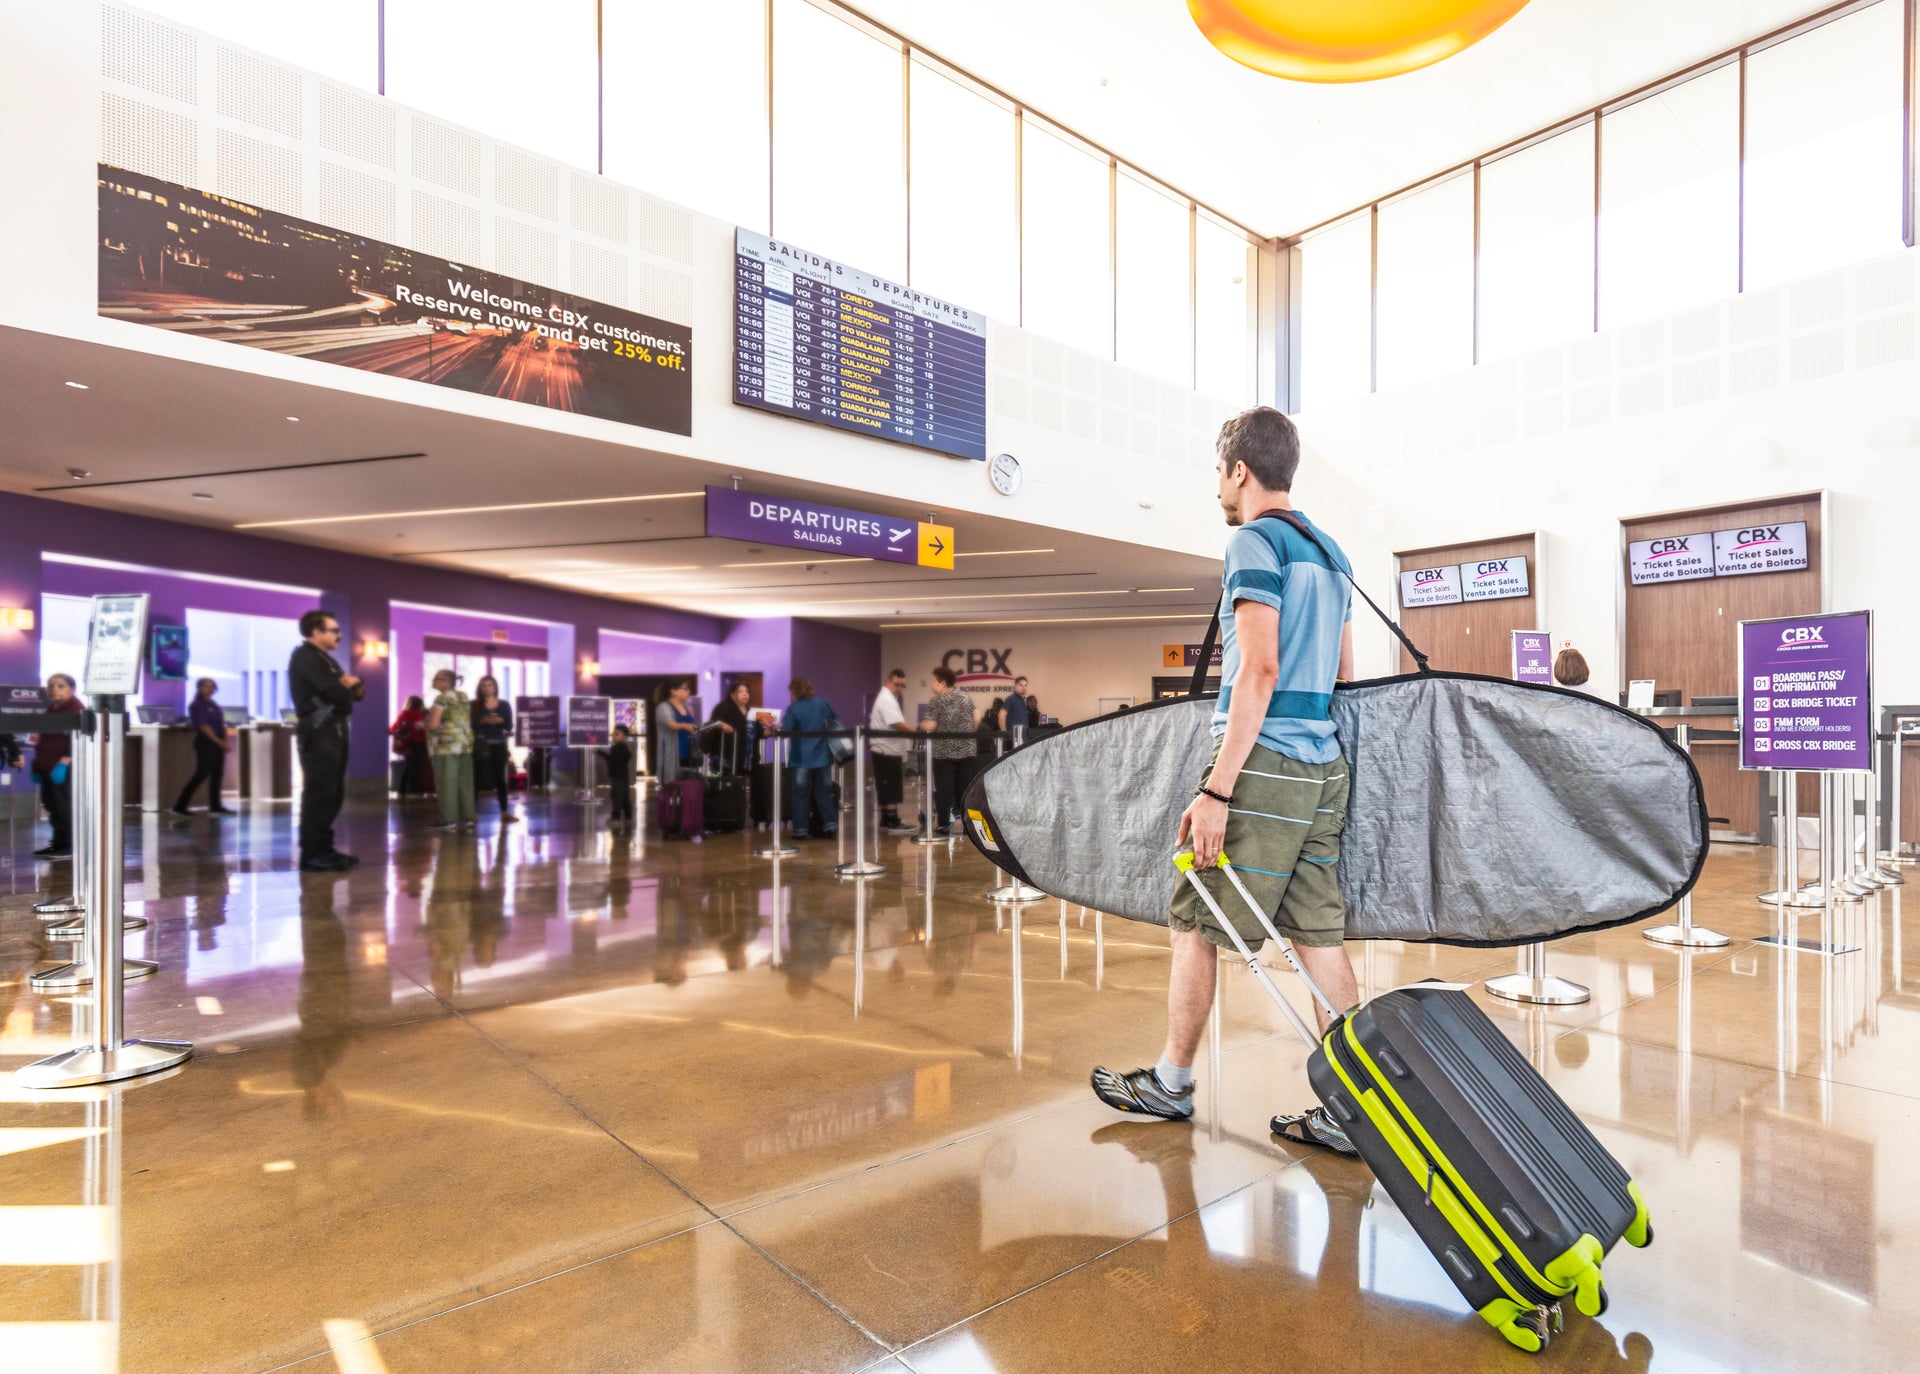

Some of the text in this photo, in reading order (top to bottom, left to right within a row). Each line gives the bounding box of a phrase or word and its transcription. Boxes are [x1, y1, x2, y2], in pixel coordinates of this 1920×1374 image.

[741, 246, 760, 258] TIME
[800, 267, 827, 280] FLIGHT
[856, 286, 867, 294] TO
[892, 299, 915, 312] BOARD
[922, 310, 939, 320] GATE
[952, 320, 977, 332] REMARK
[769, 241, 843, 275] SALIDAS
[872, 278, 968, 320] DEPARTURES
[739, 258, 762, 270] 13:40
[795, 277, 814, 288] CFV
[840, 291, 874, 308] LORETO
[924, 321, 933, 329] 1A
[739, 281, 762, 293] 14:33
[795, 299, 814, 311] AMX
[821, 308, 836, 318] 177
[840, 313, 872, 329] MEXICO
[795, 288, 810, 298] VOI
[840, 303, 852, 312] CD
[853, 307, 890, 324] OBREGON
[447, 279, 686, 356] Welcome CBX customers.
[396, 285, 686, 372] Reserve now and get 25% off.
[739, 304, 762, 316] 15:24
[795, 321, 810, 331] VOI
[840, 336, 890, 356] GUADALAJARA
[795, 311, 810, 320] VOI
[840, 325, 854, 335] PTO
[856, 329, 890, 346] VALLARTA
[795, 332, 810, 343] VOI
[840, 347, 889, 366] GUANAJUATO
[795, 355, 810, 365] VOI
[840, 368, 872, 383] MEXICO
[821, 352, 836, 361] 477
[840, 358, 882, 375] CULIACAN
[739, 352, 762, 363] 16:10
[795, 367, 810, 377] VOI
[840, 379, 879, 396] TORREON
[739, 375, 762, 386] 17:03
[795, 389, 810, 398] VOI
[821, 397, 836, 406] 424
[840, 401, 890, 420] GUADALAJARA
[821, 386, 836, 394] 411
[840, 391, 890, 409] GUADALAJARA
[739, 387, 762, 398] 17:21
[795, 401, 810, 410] VOI
[821, 408, 836, 417] 414
[840, 413, 882, 428] CULIACAN
[750, 501, 881, 538] DEPARTURES
[793, 530, 842, 546] SALIDAS
[1737, 527, 1781, 544] CBX
[1650, 538, 1689, 554] CBX
[1728, 547, 1794, 560] Ticket Sales
[1477, 560, 1508, 575] CBX
[1643, 557, 1702, 569] Ticket Sales
[1718, 556, 1807, 572] Venta de Boletos
[1415, 569, 1443, 582] CBX
[1634, 566, 1714, 581] Venta de Boletos
[1413, 585, 1450, 595] Ticket Sales
[1465, 590, 1486, 598] Venta
[1499, 586, 1528, 595] Boletos
[1472, 580, 1496, 588] Ticket
[1408, 596, 1424, 604] Venta
[1523, 638, 1540, 647] CBX
[1782, 626, 1823, 644] CBX
[942, 648, 1013, 676] CBX
[1756, 670, 1845, 688] 01 BOARDING PASS/
[1773, 681, 1836, 692] CONFIRMATION
[11, 689, 38, 697] CBX
[1755, 697, 1857, 709] 02 CBX BRIDGE TICKET
[1755, 717, 1820, 729] 03 FMM FORM
[1755, 741, 1856, 750] 04 CROSS CBX BRIDGE
